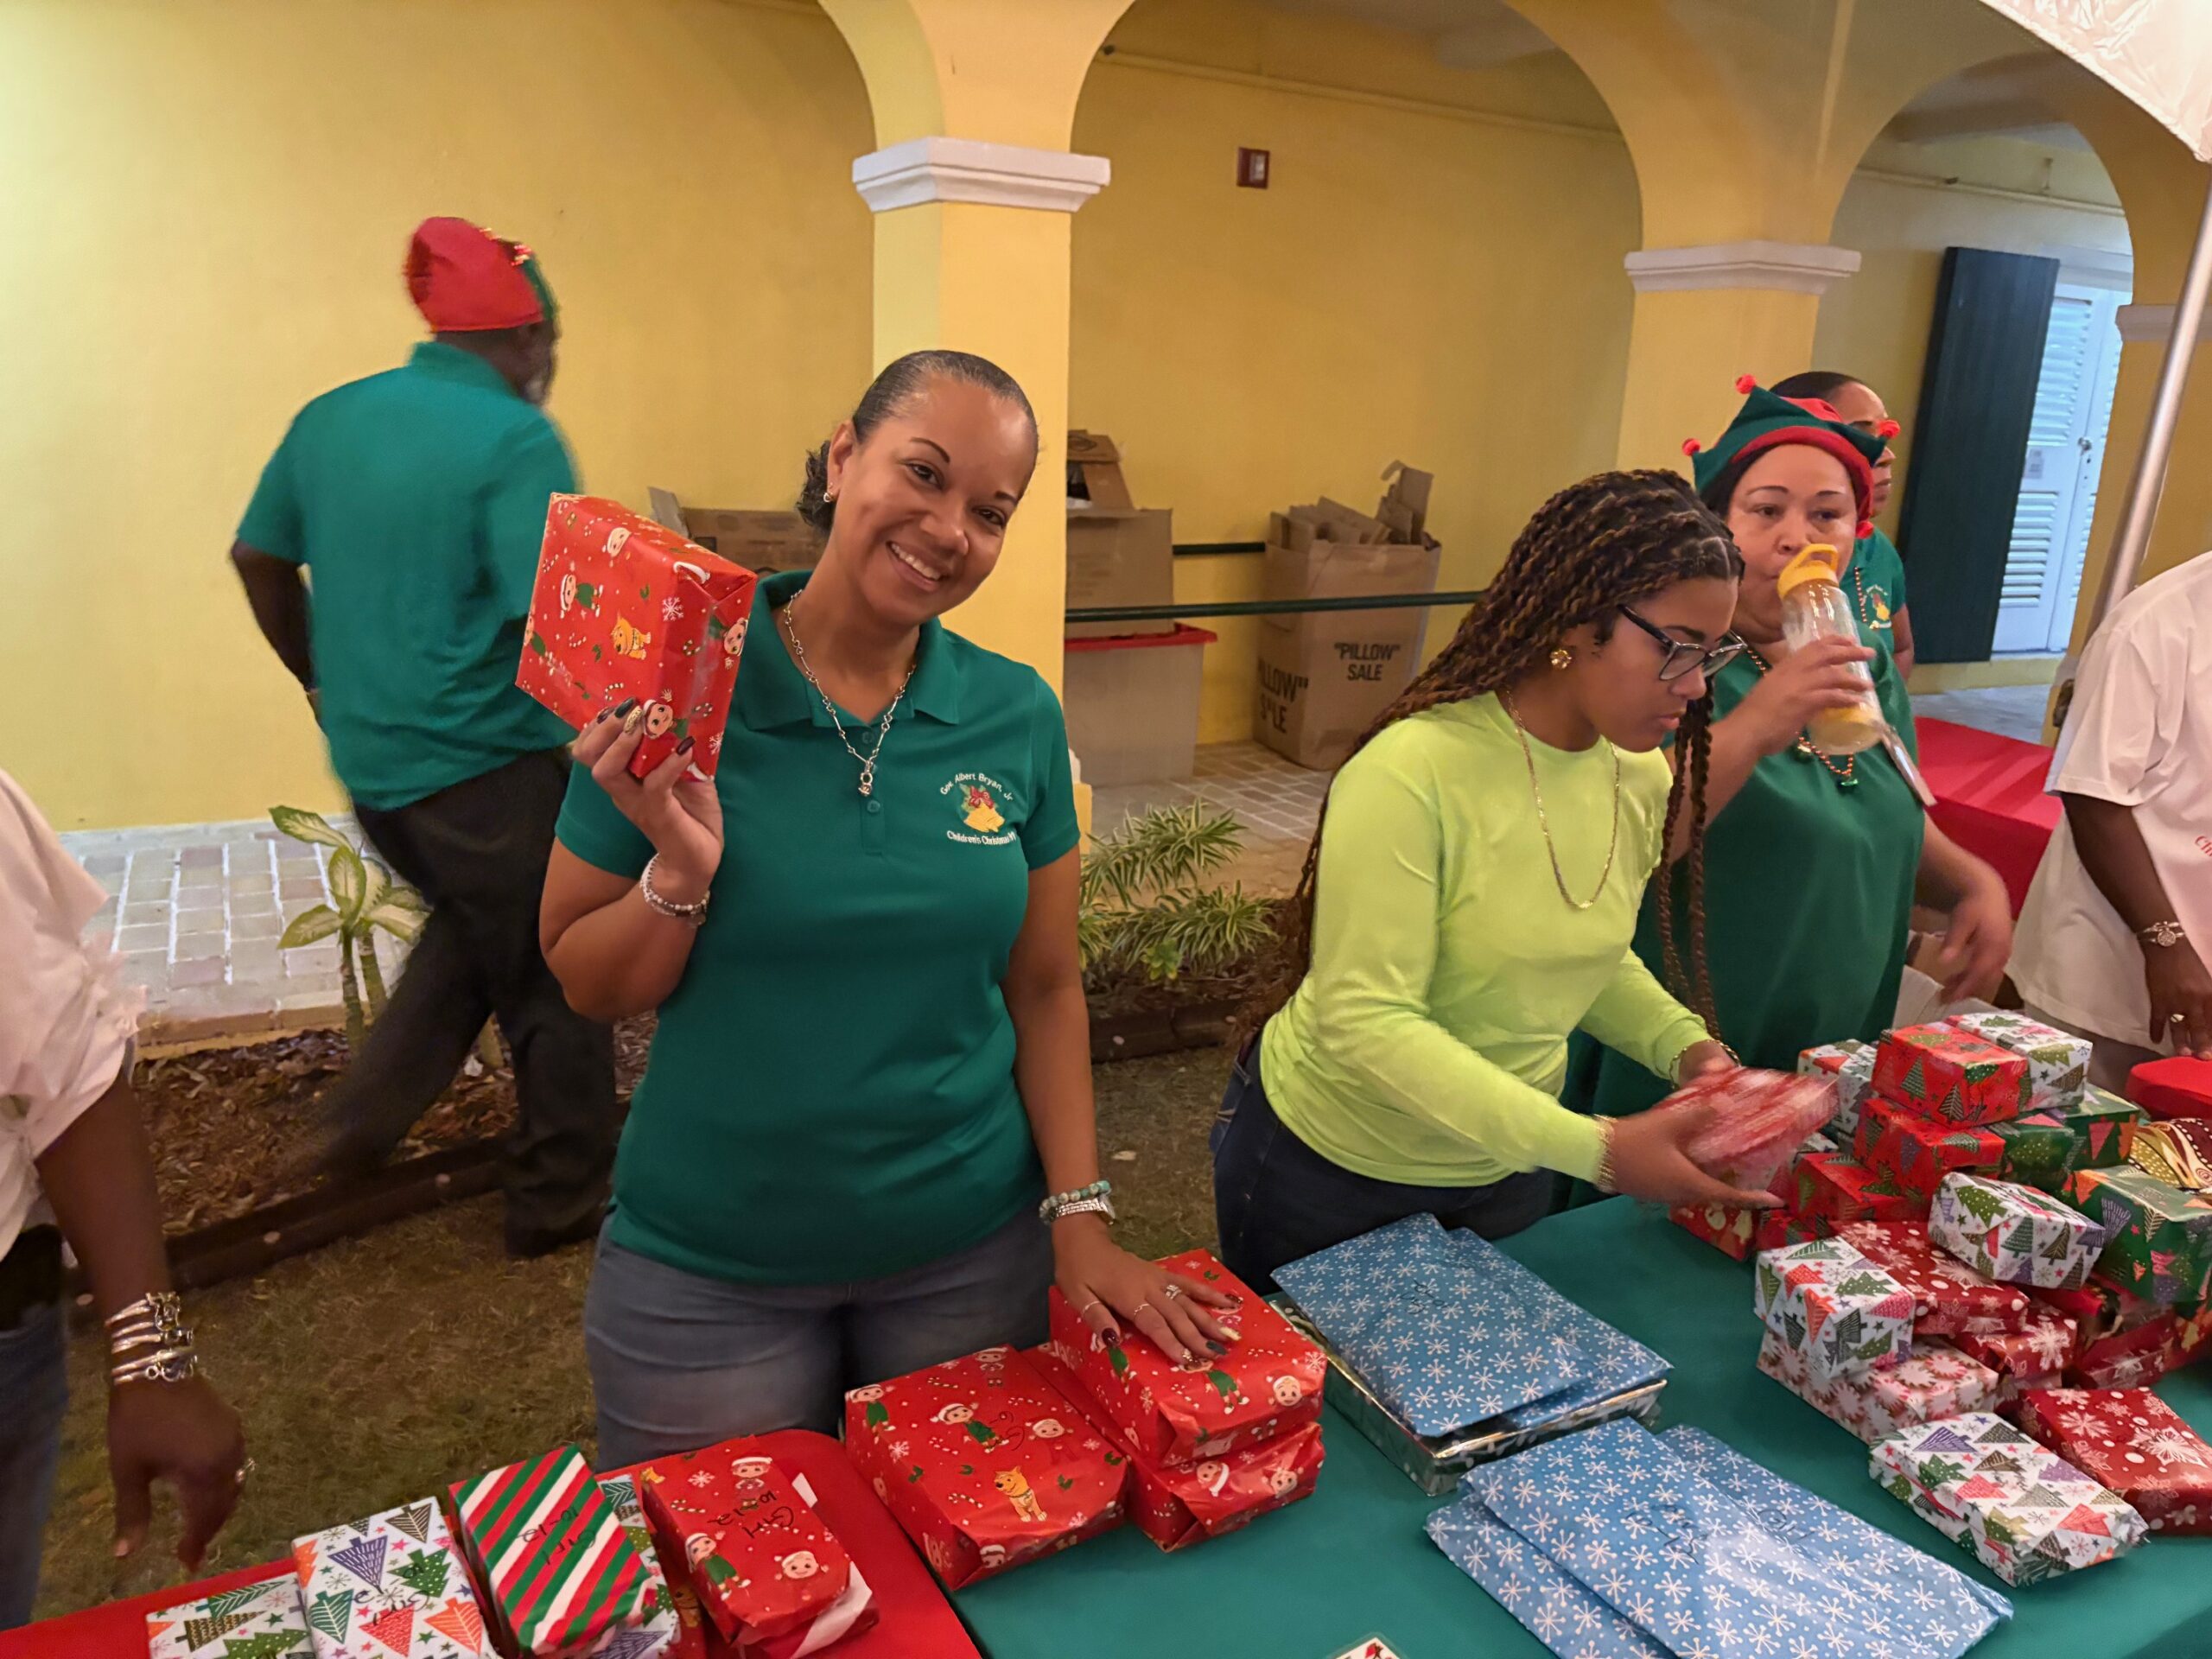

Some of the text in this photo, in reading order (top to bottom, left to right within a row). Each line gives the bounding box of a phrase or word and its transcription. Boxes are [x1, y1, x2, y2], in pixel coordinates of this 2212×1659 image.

[1334, 642, 1401, 661] "PILLOW"
[1347, 664, 1382, 681] SALE
[955, 772, 976, 783] Albert
